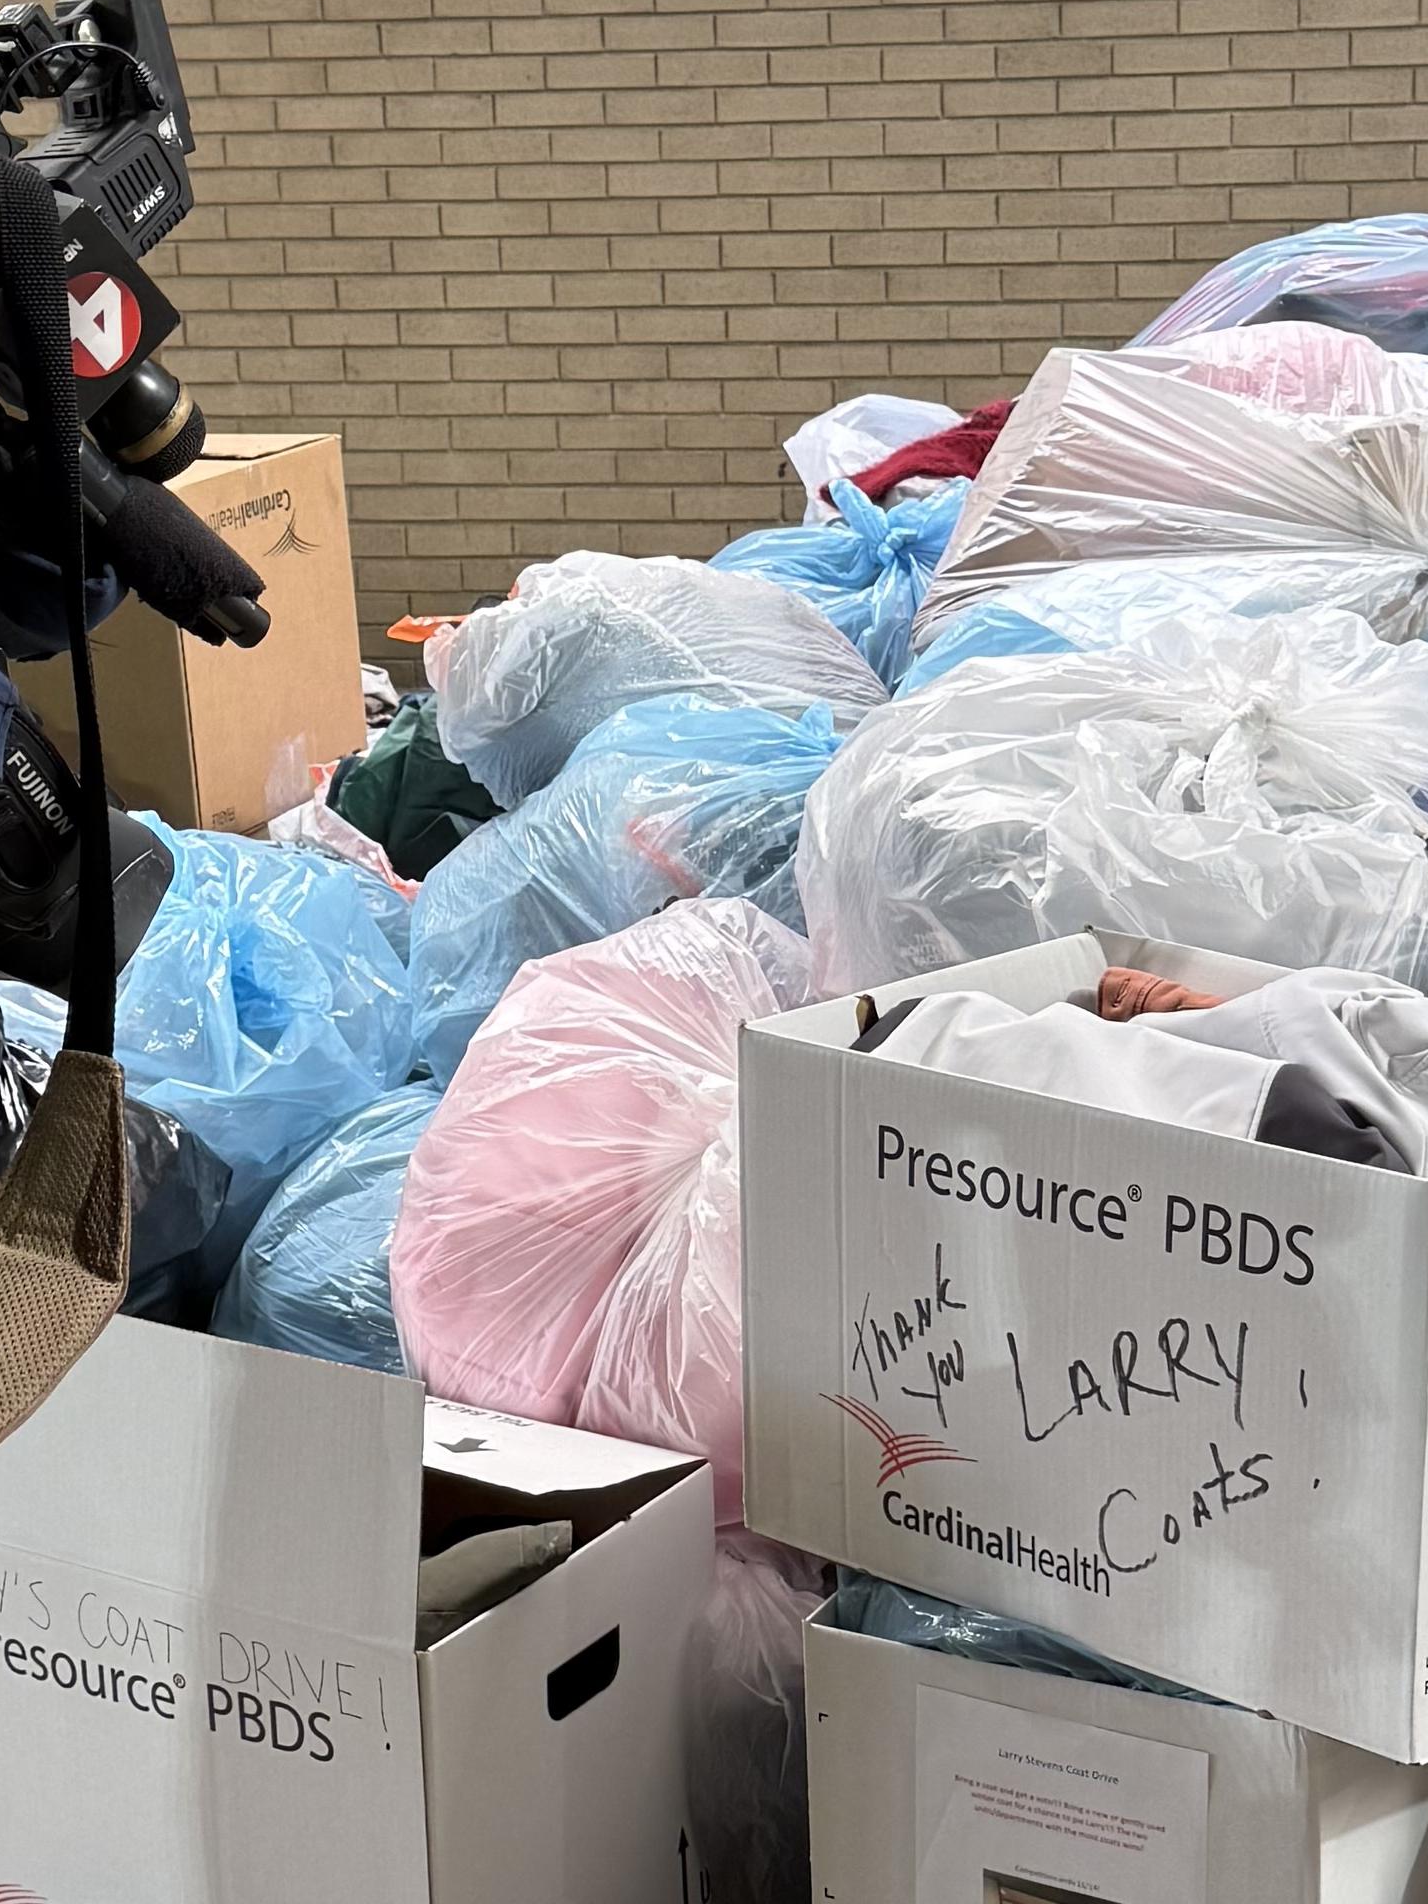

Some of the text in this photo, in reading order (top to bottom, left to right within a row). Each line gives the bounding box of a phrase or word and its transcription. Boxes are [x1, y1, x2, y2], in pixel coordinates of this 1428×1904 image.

[132, 185, 166, 223] SWIT
[6, 750, 75, 836] FUJINON
[1165, 1195, 1315, 1286] PBDS
[883, 1491, 1111, 1596] CardinalHealth
[77, 1592, 184, 1664] COAT
[206, 1683, 335, 1762] PBDS
[999, 1748, 1119, 1784] Larry Stevens Coat Drive
